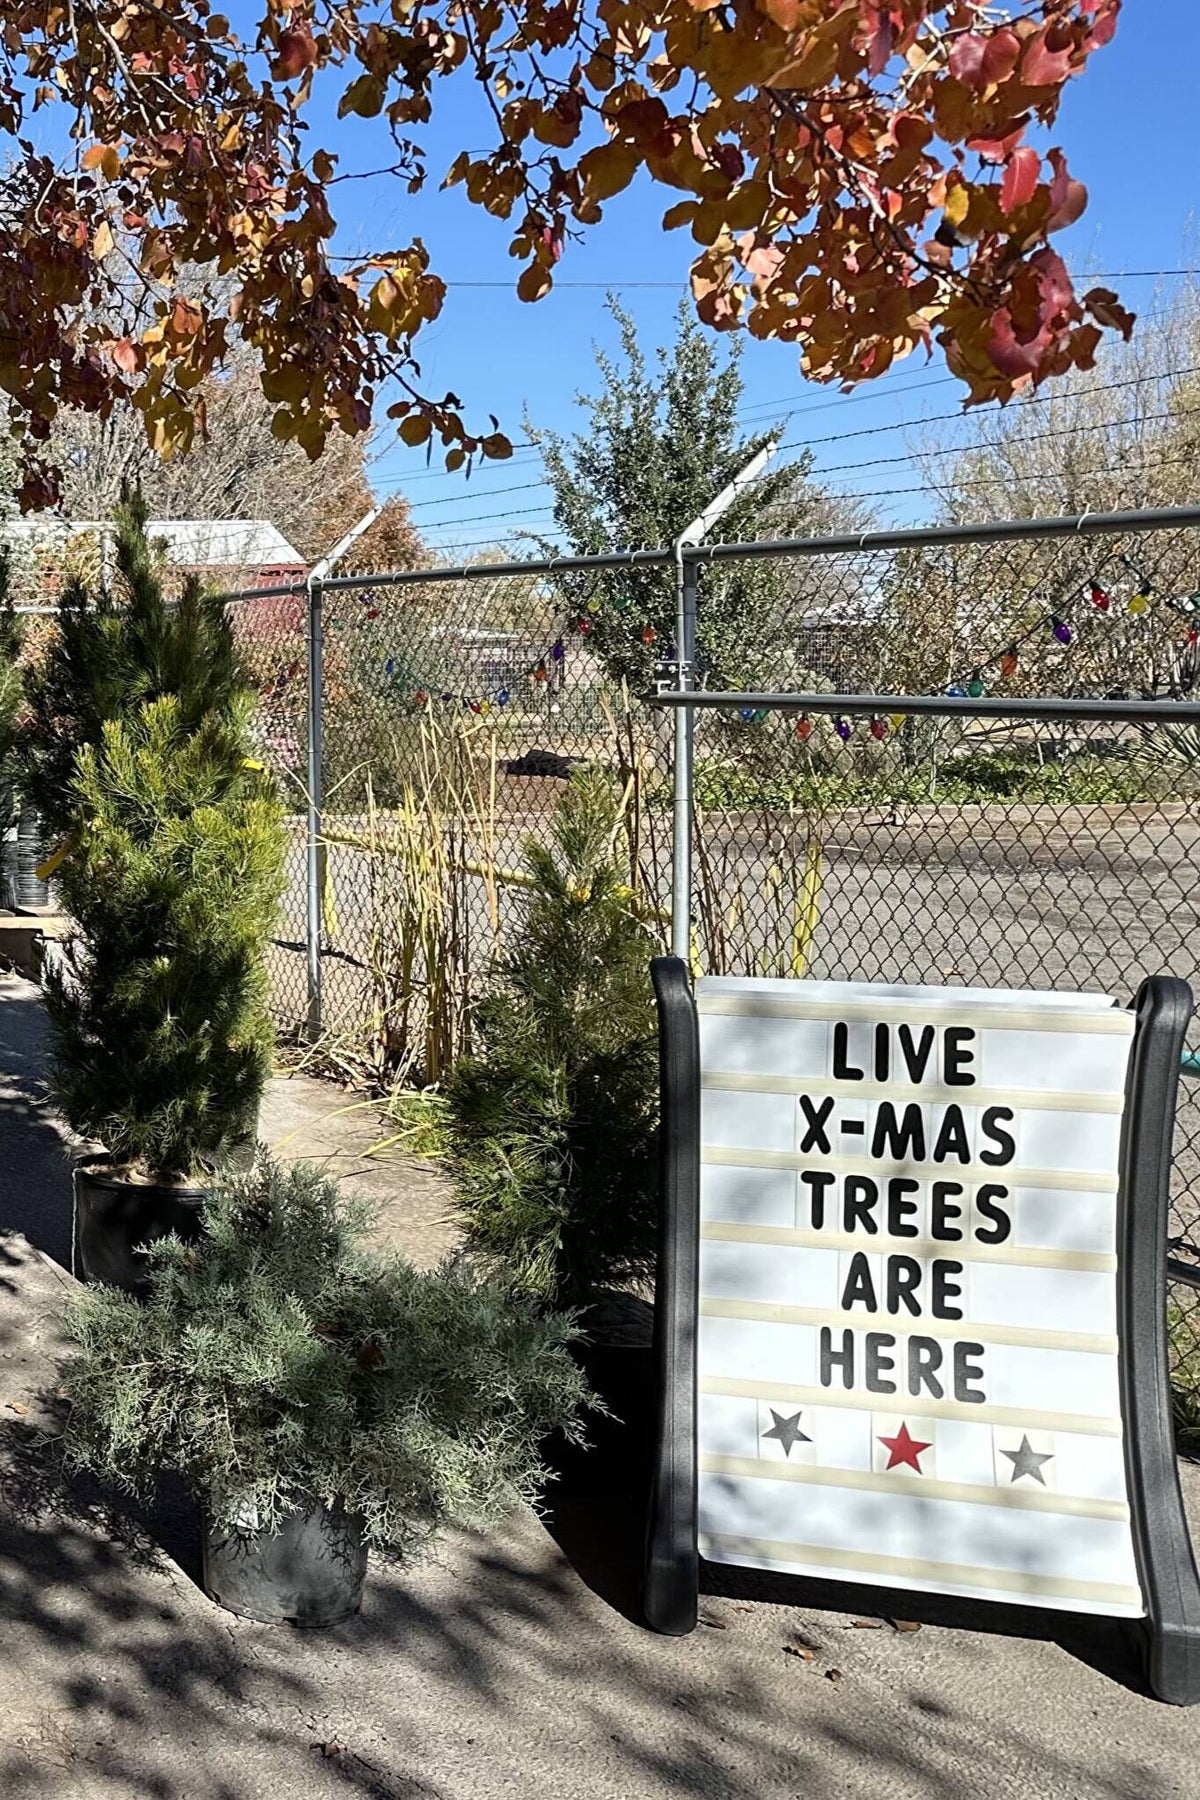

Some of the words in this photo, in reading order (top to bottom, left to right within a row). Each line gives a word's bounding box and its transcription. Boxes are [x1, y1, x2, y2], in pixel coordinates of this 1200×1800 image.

[832, 1021, 976, 1087] LIVE
[799, 1094, 1016, 1167] X-MAS
[800, 1170, 1011, 1245] TREES
[841, 1251, 964, 1321] ARE
[819, 1326, 987, 1404] HERE
